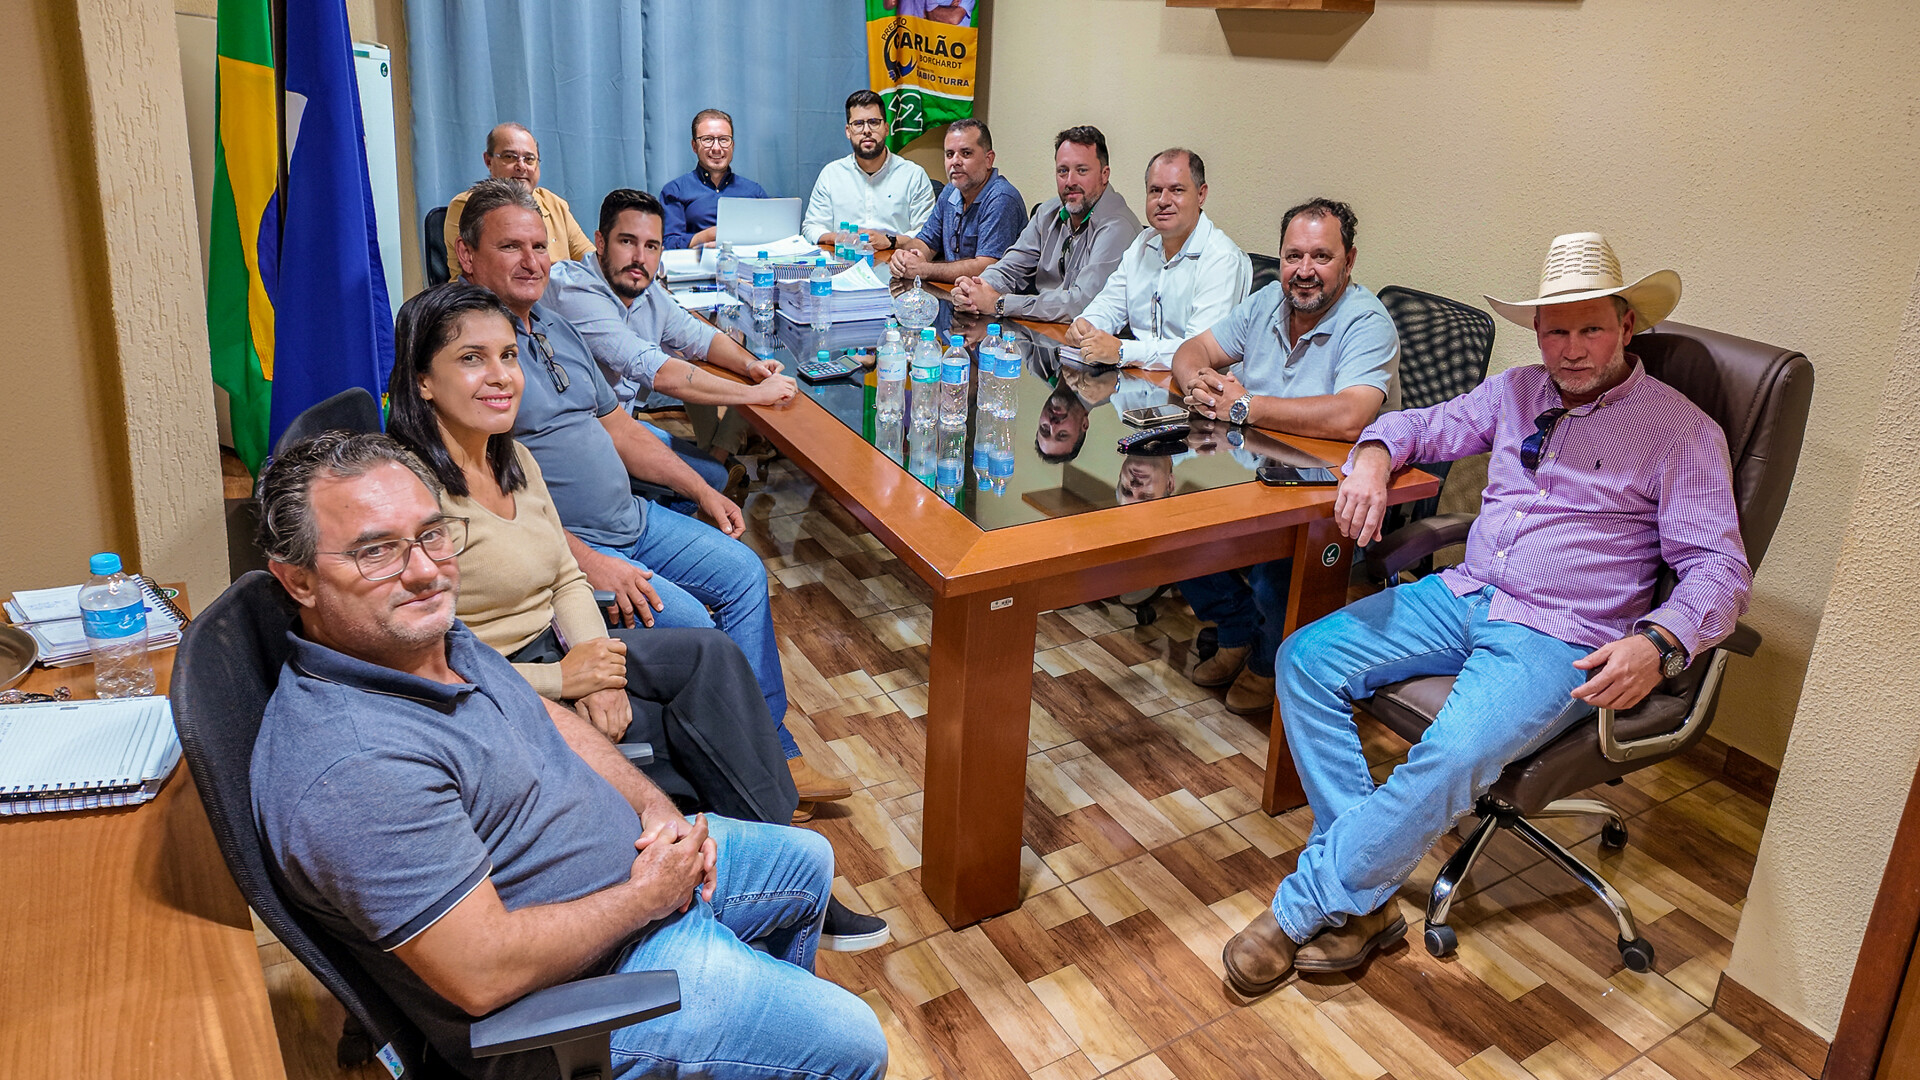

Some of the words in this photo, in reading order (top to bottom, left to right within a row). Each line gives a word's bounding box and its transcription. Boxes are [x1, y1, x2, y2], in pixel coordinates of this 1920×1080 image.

[894, 32, 966, 59] CARLÃO
[919, 55, 962, 69] BORCHARDT
[938, 76, 969, 87] TURRA
